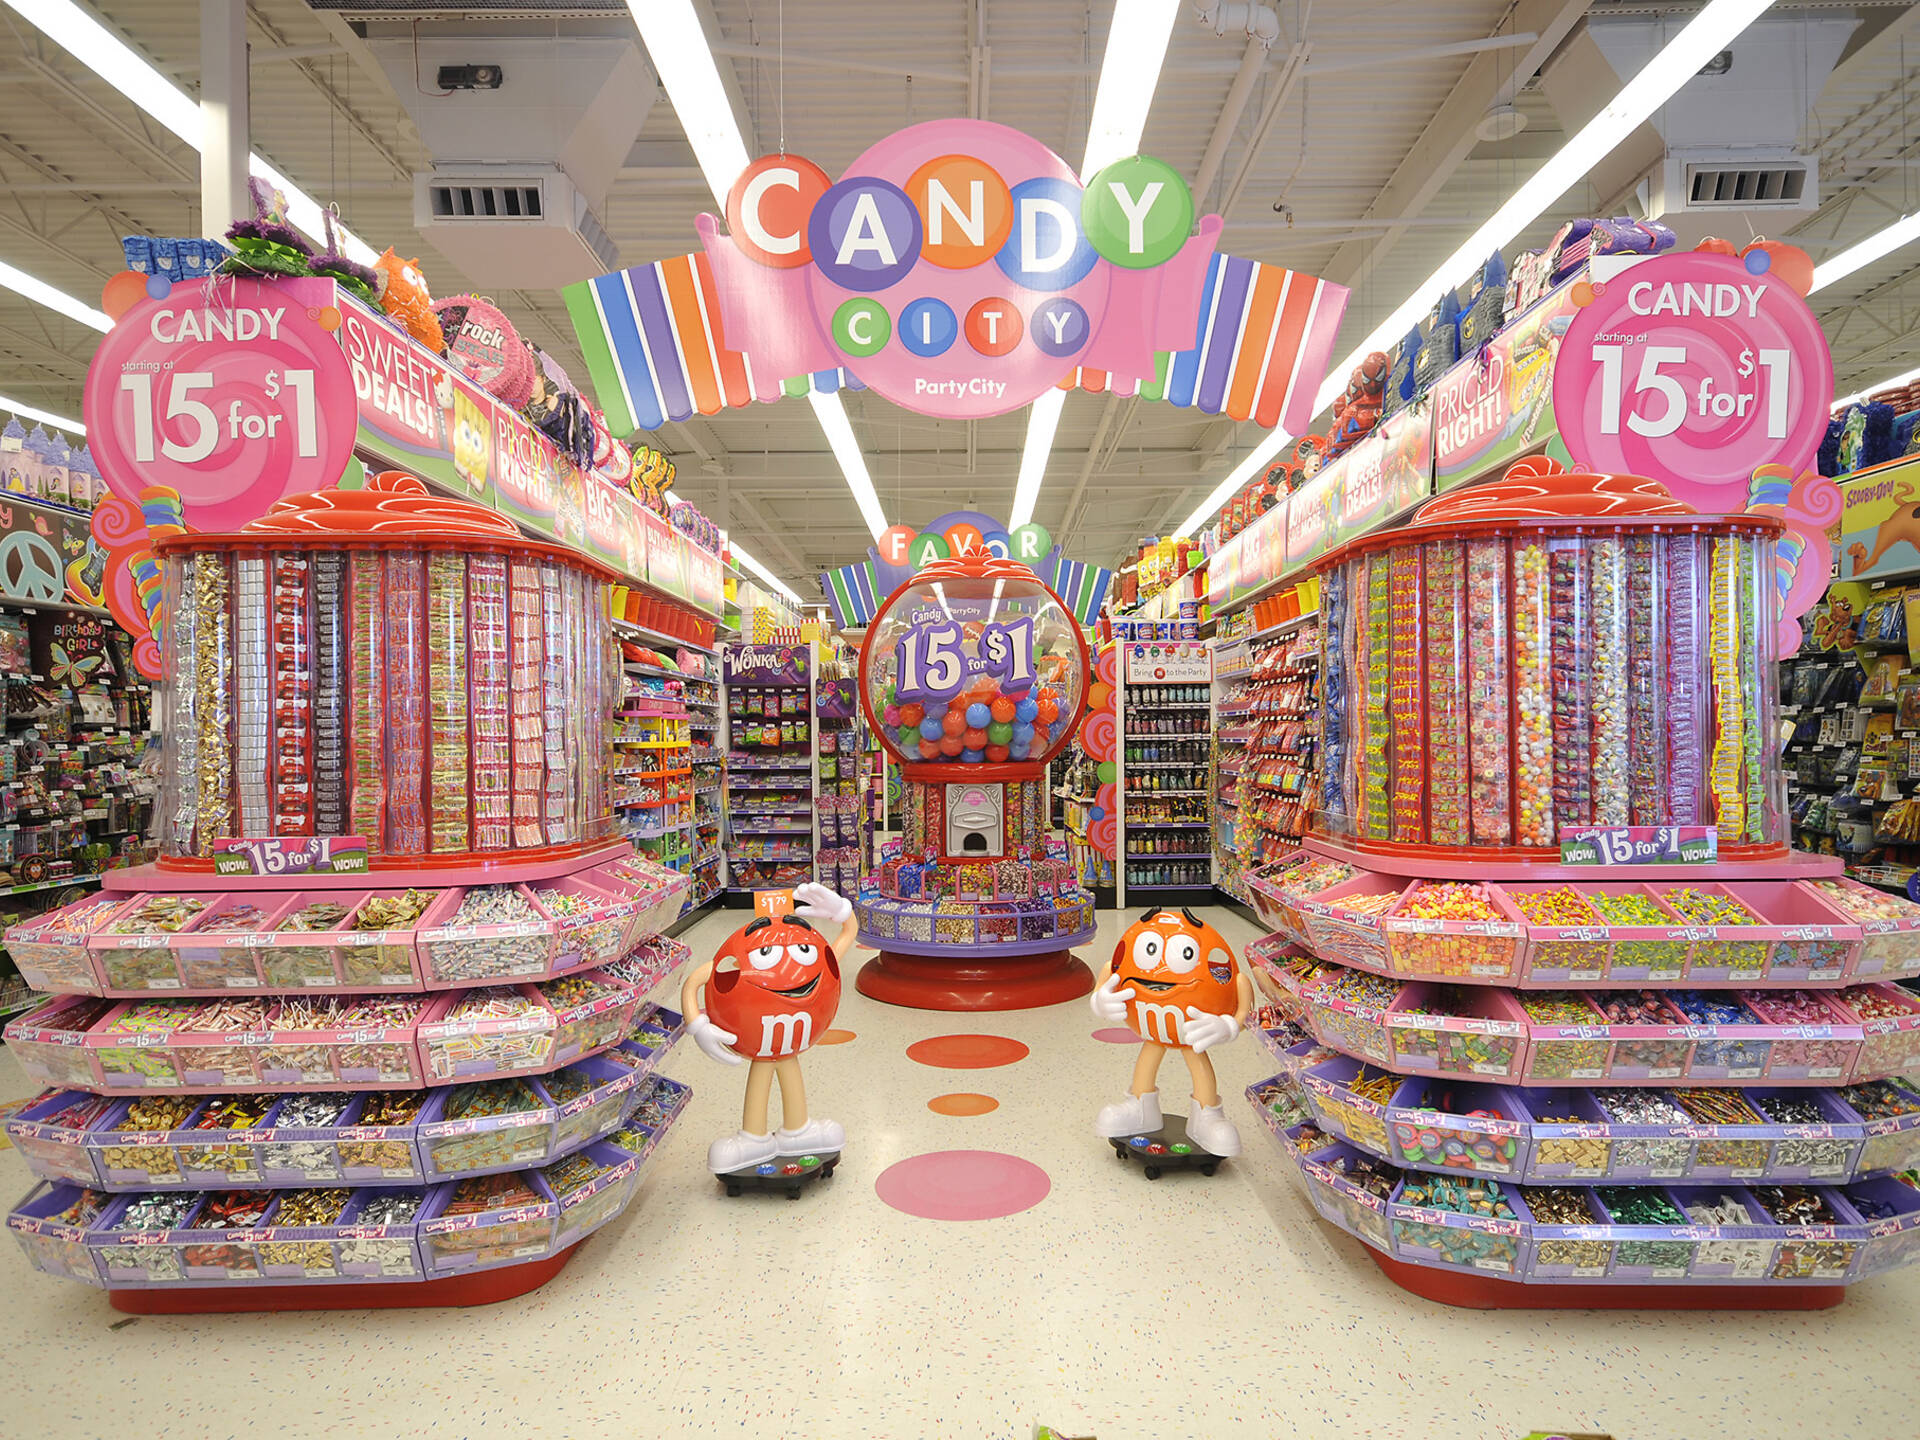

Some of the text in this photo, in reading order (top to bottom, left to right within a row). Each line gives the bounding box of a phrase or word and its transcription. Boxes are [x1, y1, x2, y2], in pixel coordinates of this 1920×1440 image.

[757, 167, 1165, 273] CANDY
[1627, 282, 1768, 319] CANDY
[150, 307, 286, 344] CANDY
[847, 310, 1070, 345] CITY
[460, 320, 505, 350] rock
[1594, 331, 1648, 344] starting at
[347, 317, 431, 403] SWEET
[455, 339, 504, 367] STAR
[121, 361, 174, 373] starting at
[915, 378, 1006, 399] PartyCity
[1439, 355, 1504, 427] PRICED
[1591, 345, 1687, 438] 15
[1698, 377, 1753, 418] for
[1737, 347, 1791, 439] $1
[351, 358, 434, 440] DEALS!
[121, 369, 315, 464] 15 for $1
[1438, 391, 1502, 458] RIGHT!
[498, 417, 548, 475] PRICED
[501, 452, 550, 504] RIGHT!
[586, 479, 613, 524] BIG
[1346, 476, 1382, 517] DEALS!
[892, 531, 1039, 567] FAVOR
[912, 609, 942, 624] Candy
[901, 623, 1031, 692] 15 for $1
[1134, 668, 1153, 678] Bring
[1175, 668, 1186, 676] the
[1575, 827, 1680, 865] Candy 15 for $1
[228, 838, 331, 875] Candy 15 for $1
[1565, 850, 1595, 862] WOW!
[1681, 848, 1713, 862] WOW!
[219, 861, 249, 874] WOW!
[333, 858, 364, 871] WOW!
[1577, 928, 1591, 940] 15
[1685, 927, 1699, 940] 15
[1800, 927, 1814, 940] 15
[1136, 1001, 1193, 1045] m
[757, 1012, 812, 1056] m
[1413, 1112, 1424, 1124] 5
[243, 1129, 254, 1142] 5
[354, 1127, 365, 1140] 5
[1487, 1121, 1498, 1134] 5
[1509, 1123, 1520, 1135] $1
[1580, 1124, 1590, 1138] 5
[1687, 1125, 1698, 1138] 5
[1802, 1126, 1812, 1138] 5
[137, 1131, 147, 1144] 5
[444, 1220, 455, 1232] 5
[466, 1215, 478, 1227] $1
[516, 1210, 527, 1222] 5
[1413, 1209, 1425, 1223] 5
[1435, 1210, 1446, 1224] $1
[355, 1226, 365, 1239] 5
[1487, 1220, 1498, 1234] 5
[1510, 1221, 1521, 1236] $1
[1803, 1227, 1814, 1240] 5
[138, 1231, 148, 1245] 5
[243, 1230, 254, 1242] 5
